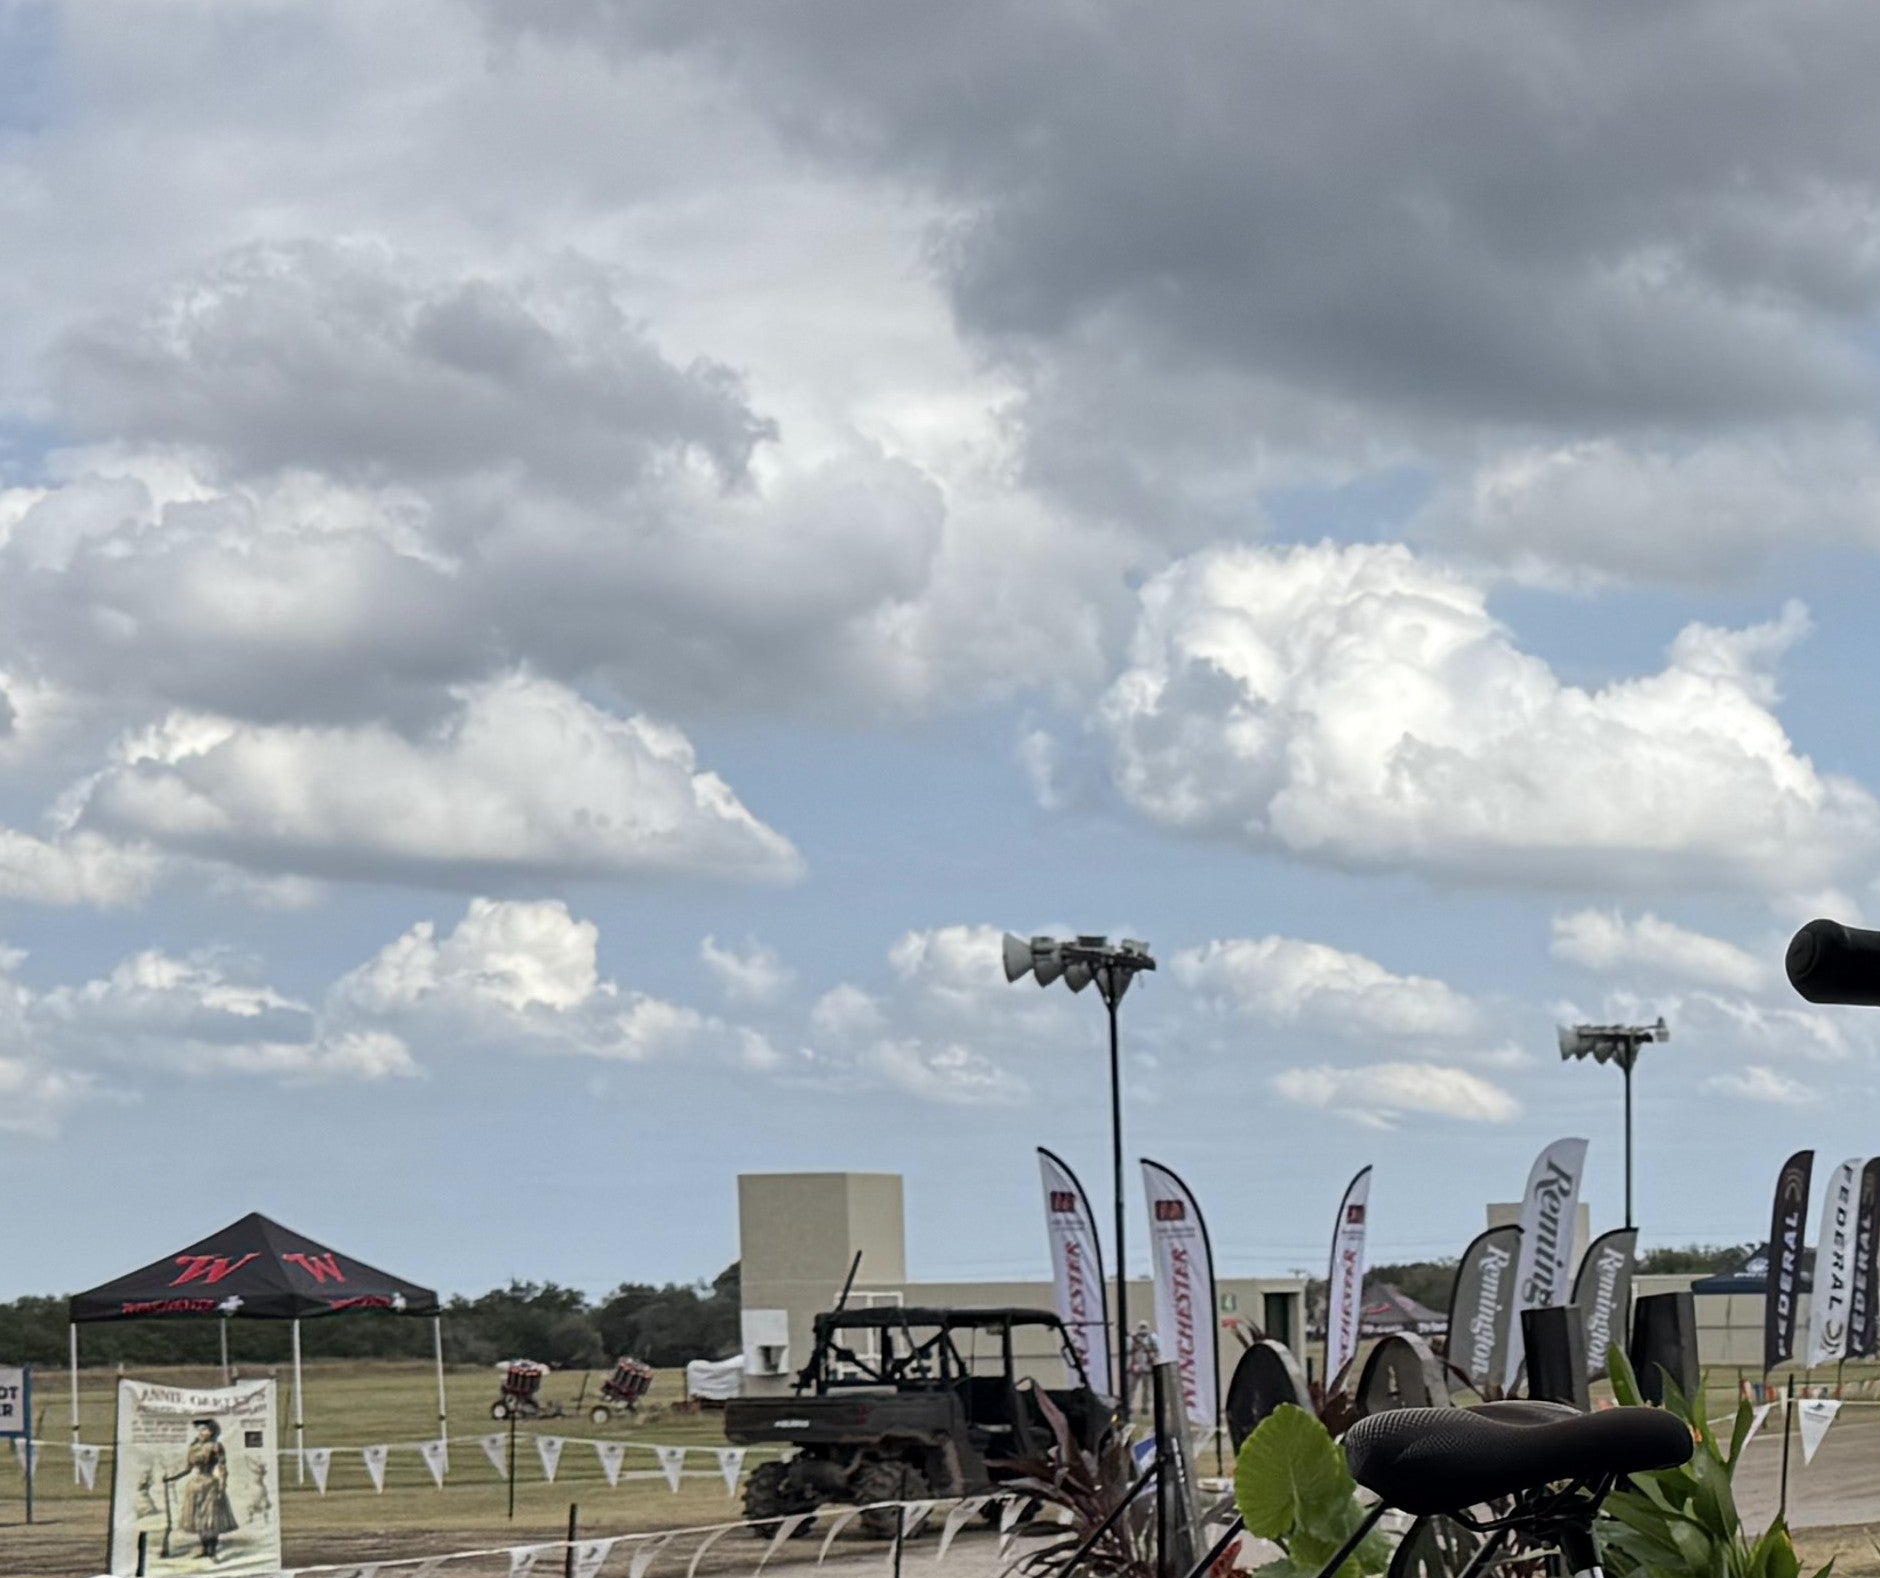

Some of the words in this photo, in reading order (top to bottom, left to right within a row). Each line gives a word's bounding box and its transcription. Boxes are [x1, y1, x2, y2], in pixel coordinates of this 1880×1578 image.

[169, 1252, 260, 1287] W
[282, 1252, 346, 1284] W
[1778, 1211, 1799, 1357] FEDERAL
[1828, 1164, 1853, 1312] FEDERAL
[1851, 1215, 1873, 1352] FEDERAL
[1172, 1248, 1196, 1408] WINCHESTER
[1470, 1244, 1512, 1380] Remington
[1587, 1246, 1626, 1370] Remington
